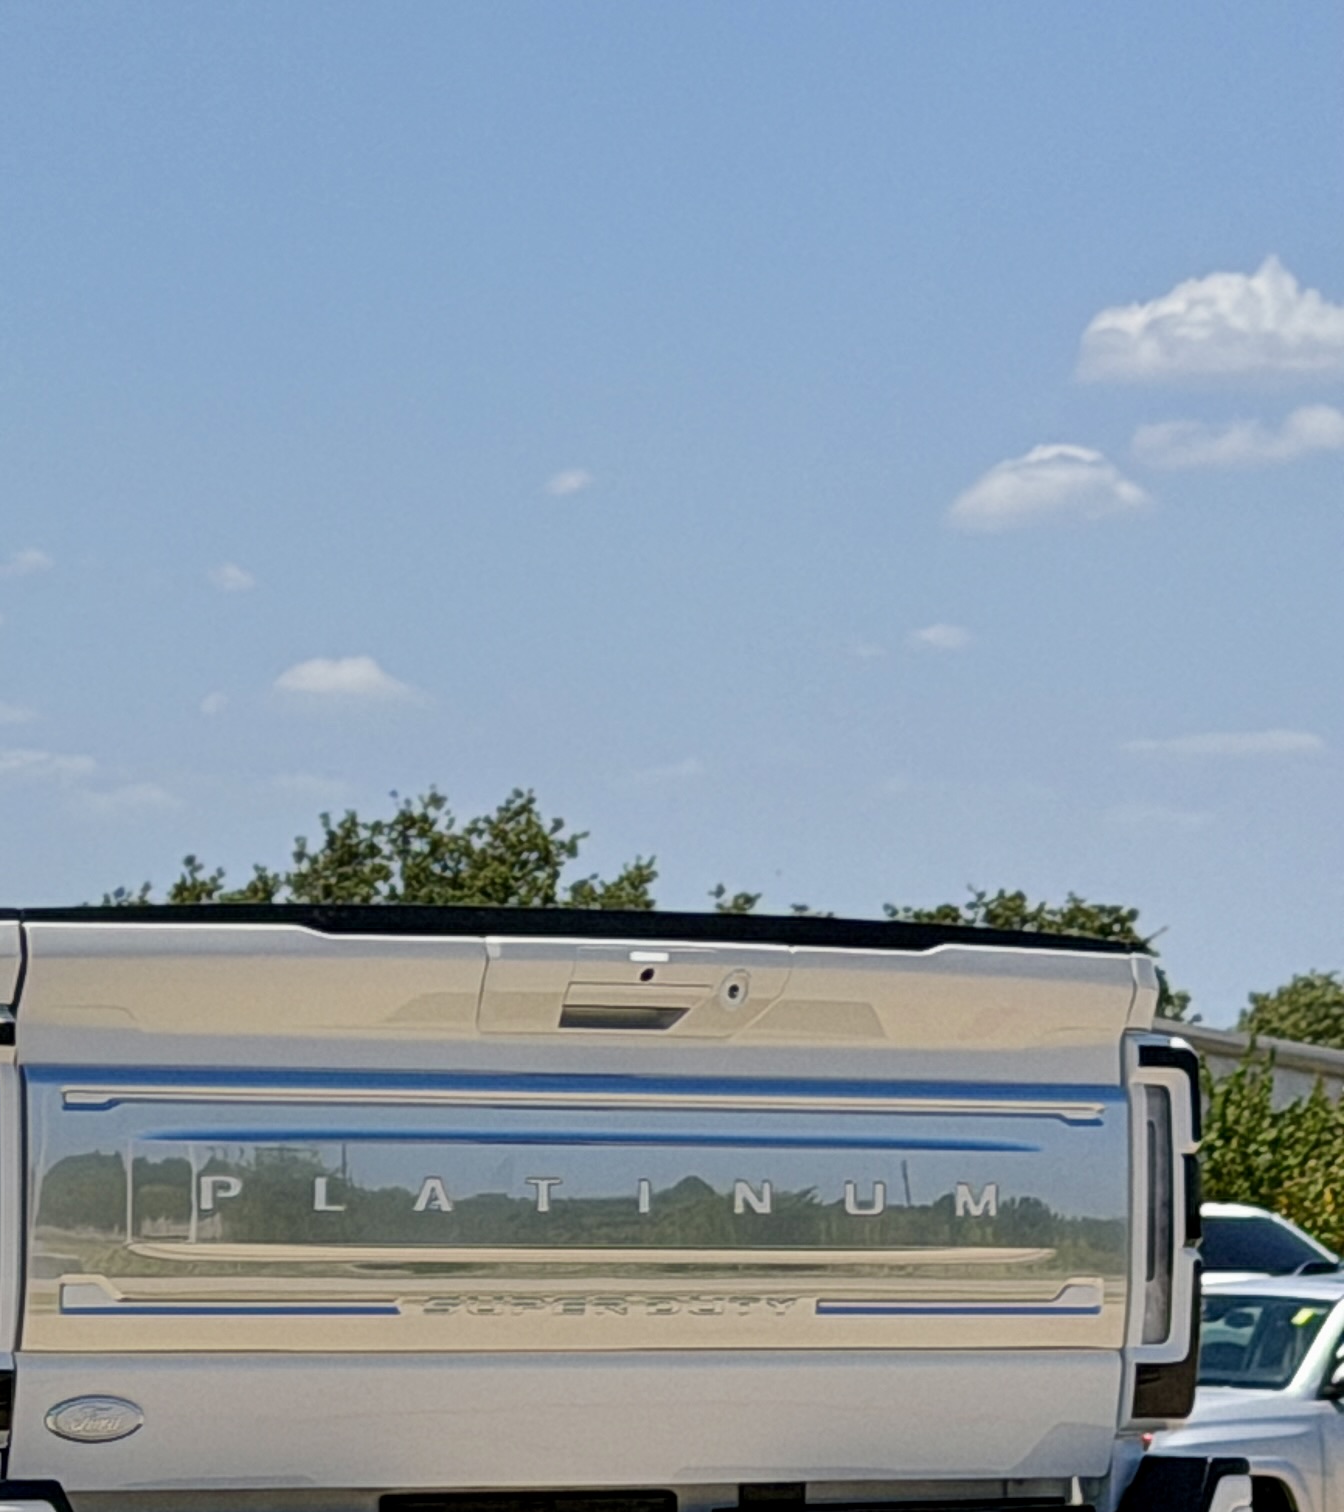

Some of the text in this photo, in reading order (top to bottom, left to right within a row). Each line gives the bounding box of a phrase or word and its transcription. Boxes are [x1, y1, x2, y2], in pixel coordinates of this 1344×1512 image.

[196, 1174, 1003, 1219] PLATINUM
[422, 1293, 798, 1317] SUPER DUTY
[69, 1404, 123, 1433] Ford
